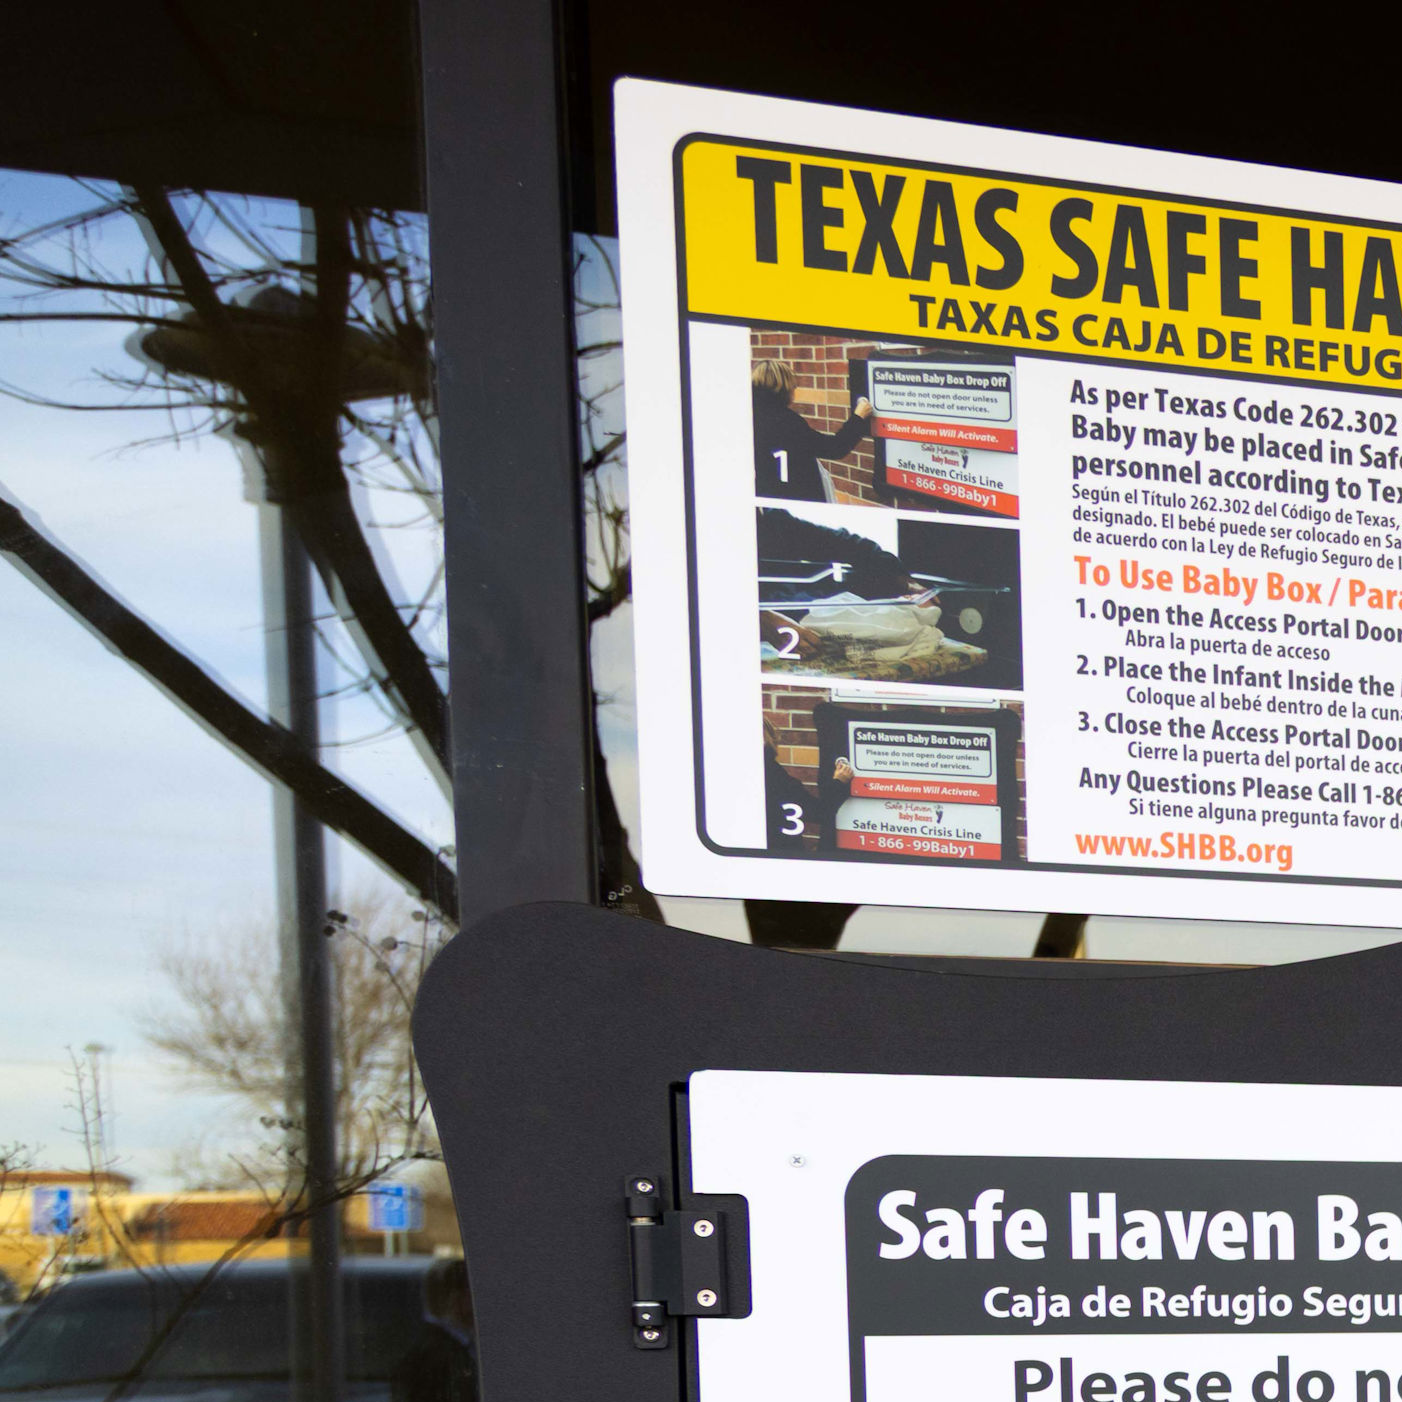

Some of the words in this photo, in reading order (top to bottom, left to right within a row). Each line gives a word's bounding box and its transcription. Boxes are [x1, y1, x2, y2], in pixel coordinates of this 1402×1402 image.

[736, 156, 1024, 290] TEXAS
[1050, 198, 1261, 320] SAFE
[909, 294, 1059, 341] TAXAS
[1073, 314, 1184, 356] CAJA
[1198, 328, 1252, 363] DE
[1071, 380, 1097, 404] As
[1106, 390, 1148, 413] per
[1155, 388, 1226, 418] Texas
[1234, 398, 1293, 425] Code
[1301, 405, 1397, 436] 262.302
[773, 450, 788, 482] 1
[1074, 527, 1091, 542] de
[1097, 533, 1157, 548] acuerdo
[1162, 539, 1186, 550] con
[1193, 537, 1204, 552] la
[1210, 539, 1233, 558] Ley
[1239, 542, 1255, 557] de
[1261, 544, 1317, 565] Refugio
[1323, 550, 1372, 568] Seguro
[1377, 555, 1393, 569] de
[1073, 555, 1110, 586] To
[1120, 559, 1173, 592] Use
[1182, 564, 1258, 605] Baby
[1266, 572, 1322, 604] Box
[777, 626, 800, 660] 2
[1080, 768, 1120, 794] Any
[1127, 771, 1235, 796] Questions
[1243, 778, 1312, 800] Please
[1319, 783, 1355, 803] Call
[780, 803, 805, 836] 3
[853, 819, 877, 831] Safe
[880, 822, 917, 834] Haven
[920, 825, 953, 837] Crisis
[956, 828, 982, 840] Line
[1130, 799, 1143, 814] Si
[1149, 800, 1192, 817] tiene
[1199, 803, 1256, 823] alguna
[1262, 811, 1337, 828] pregunta
[1344, 811, 1385, 828] favor
[1075, 832, 1292, 872] www.SHBB.org
[879, 1189, 1047, 1260] Safe
[1071, 1192, 1294, 1260] Haven
[984, 1286, 1070, 1326] Caja
[1082, 1286, 1131, 1317] de
[1143, 1285, 1292, 1325] Refugio
